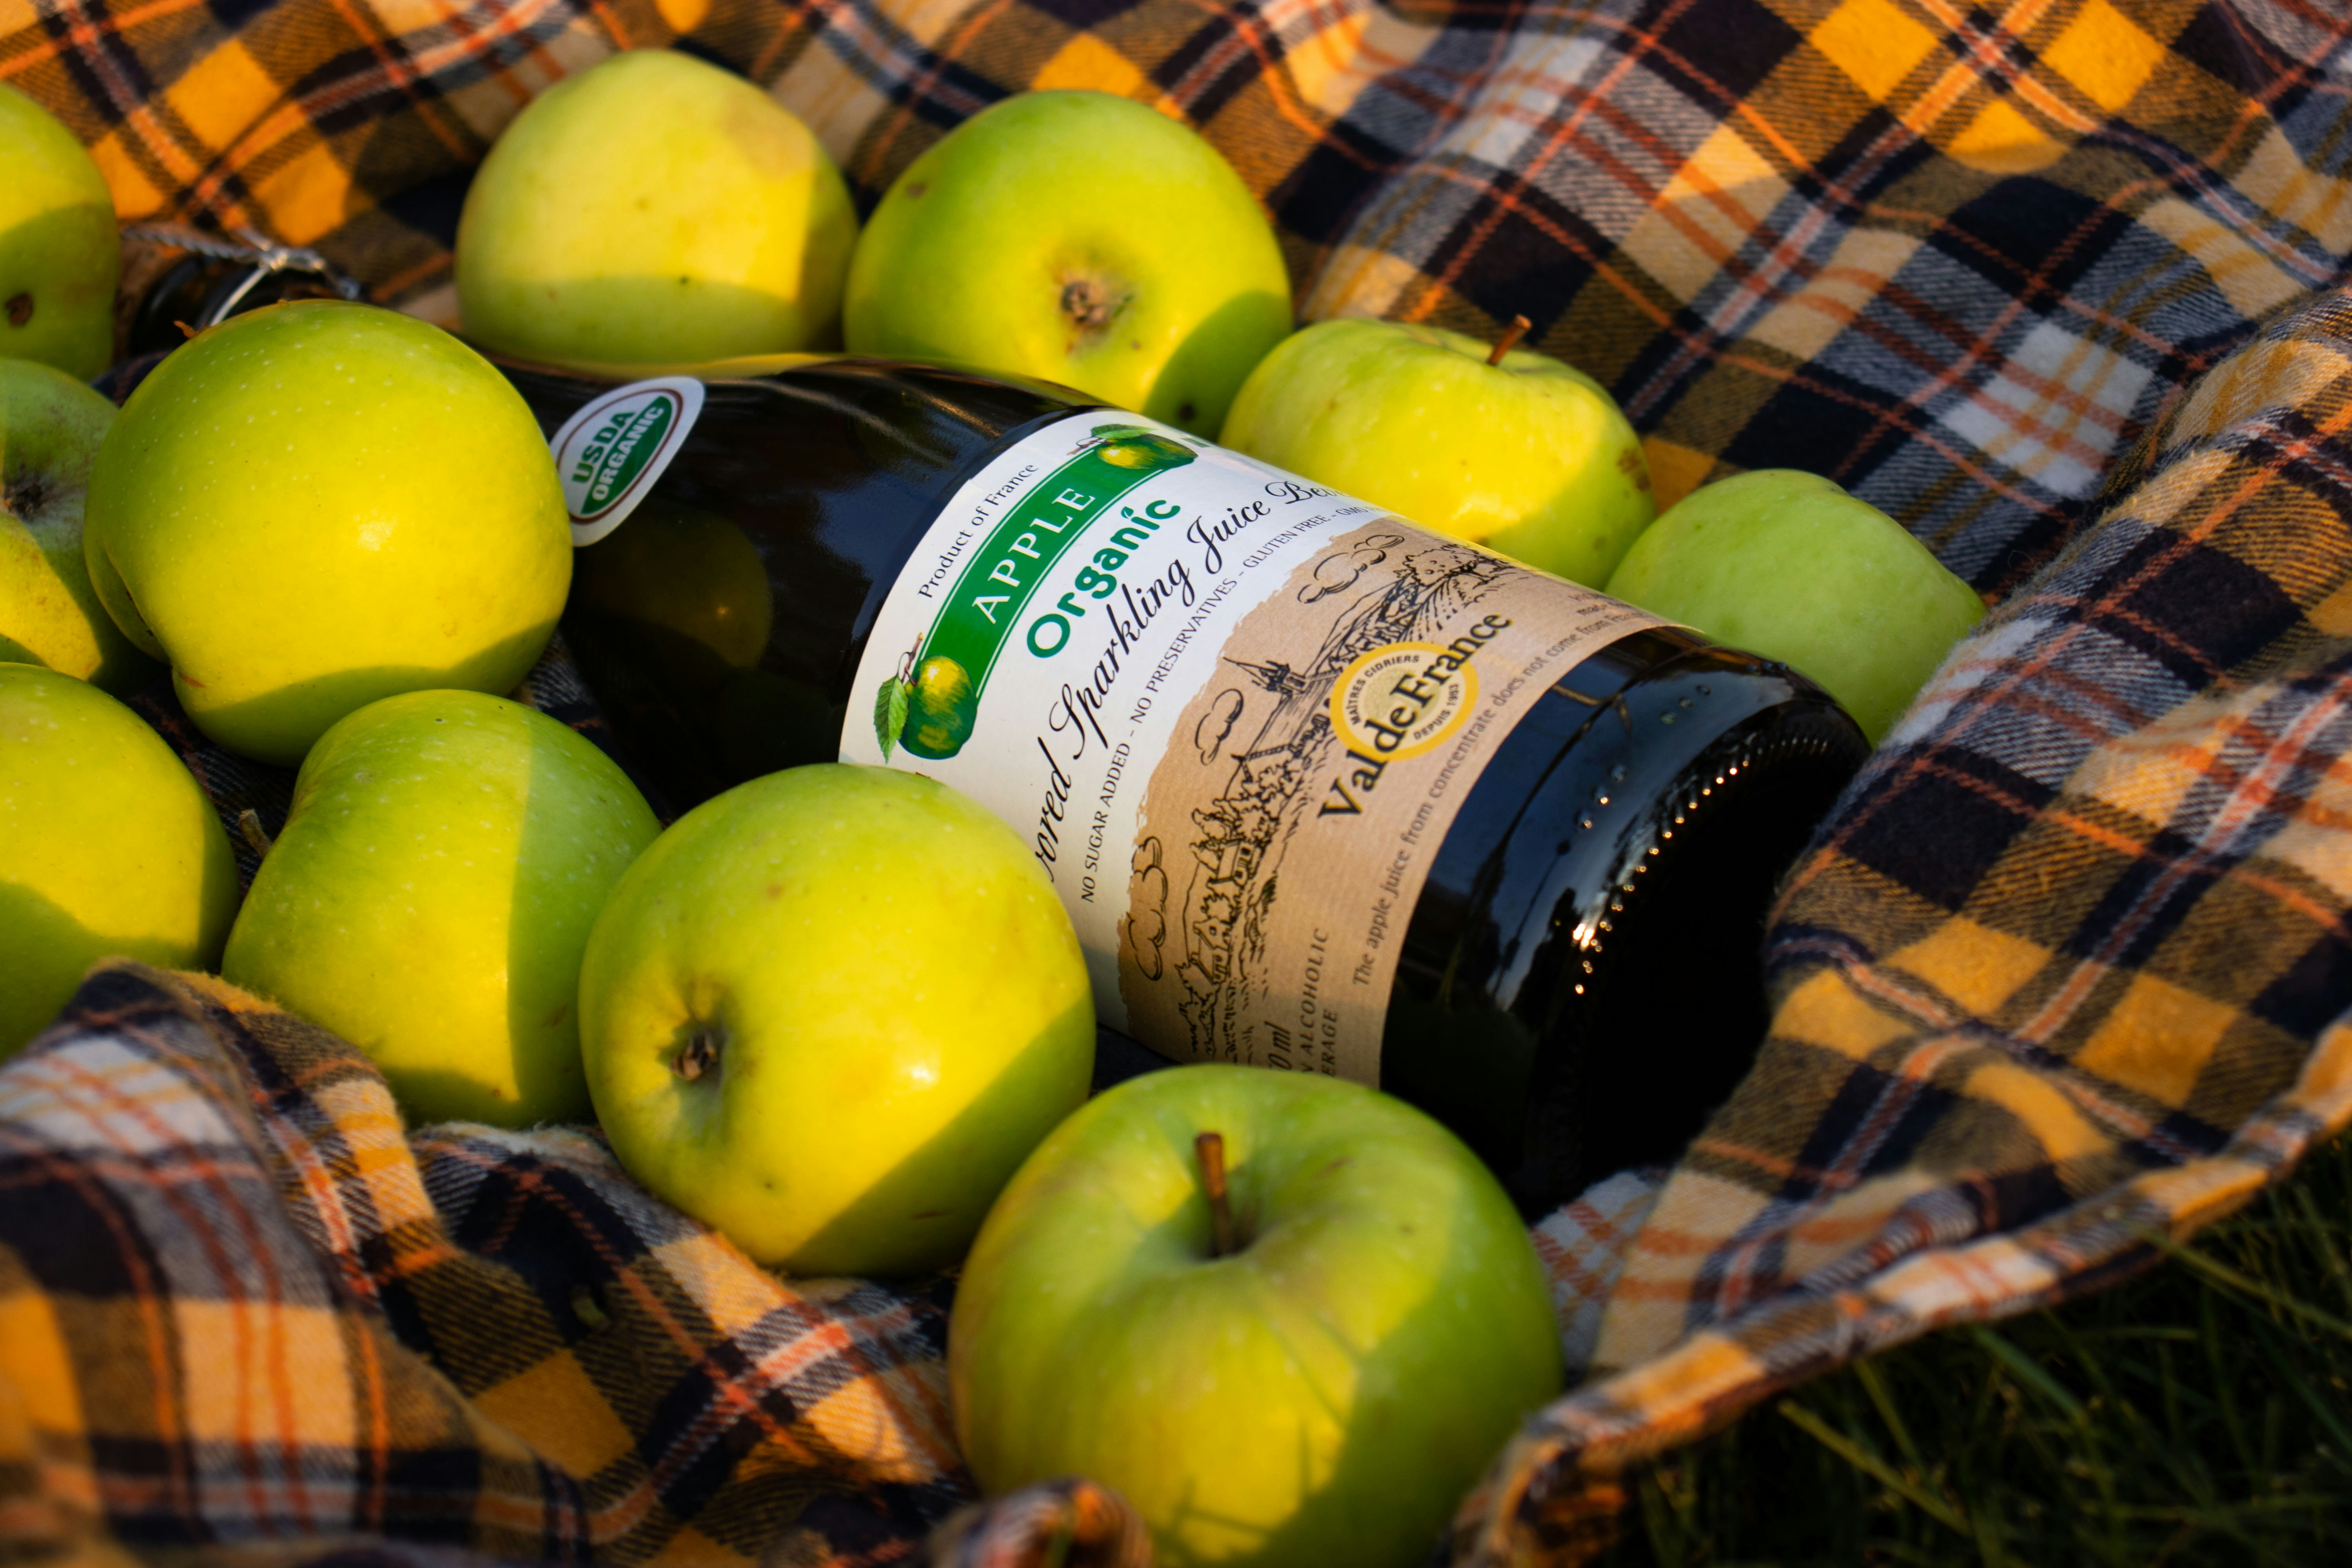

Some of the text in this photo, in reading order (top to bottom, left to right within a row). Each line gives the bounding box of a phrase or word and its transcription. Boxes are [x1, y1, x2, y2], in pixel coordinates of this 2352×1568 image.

[572, 411, 636, 483] USDA
[592, 406, 665, 501] ORGANIC
[918, 463, 1039, 599] Product of France
[1292, 515, 1332, 532] FREE
[1336, 506, 1368, 515] GMO
[972, 488, 1096, 624] APPLE
[1027, 499, 1181, 658] Organic
[1243, 530, 1298, 569] GLUTEN
[1049, 559, 1195, 760] Sparkling
[1187, 501, 1271, 574] Juice
[1146, 577, 1238, 693] PRESERVATIVES
[1130, 697, 1152, 724] NO
[1318, 750, 1390, 819] Val
[1389, 614, 1513, 710] France
[1347, 655, 1420, 725] MAÎTRES CIDRIERS
[1413, 710, 1451, 740] DEPUIS
[1100, 743, 1130, 808] ADDED
[1353, 953, 1375, 985] The
[1367, 898, 1391, 949] apple
[1380, 851, 1410, 898] juice
[1399, 803, 1433, 845] from
[1429, 708, 1496, 798] concentrate
[1492, 674, 1525, 707] does
[1523, 655, 1550, 681] not
[1545, 633, 1583, 658] come
[1575, 619, 1612, 636] from
[1085, 810, 1109, 872] SUGAR
[1081, 877, 1095, 903] NO
[1300, 928, 1329, 1056] ALCOHOLIC
[1263, 1020, 1292, 1071] 0 ml
[1321, 1009, 1338, 1077] ERAGE
